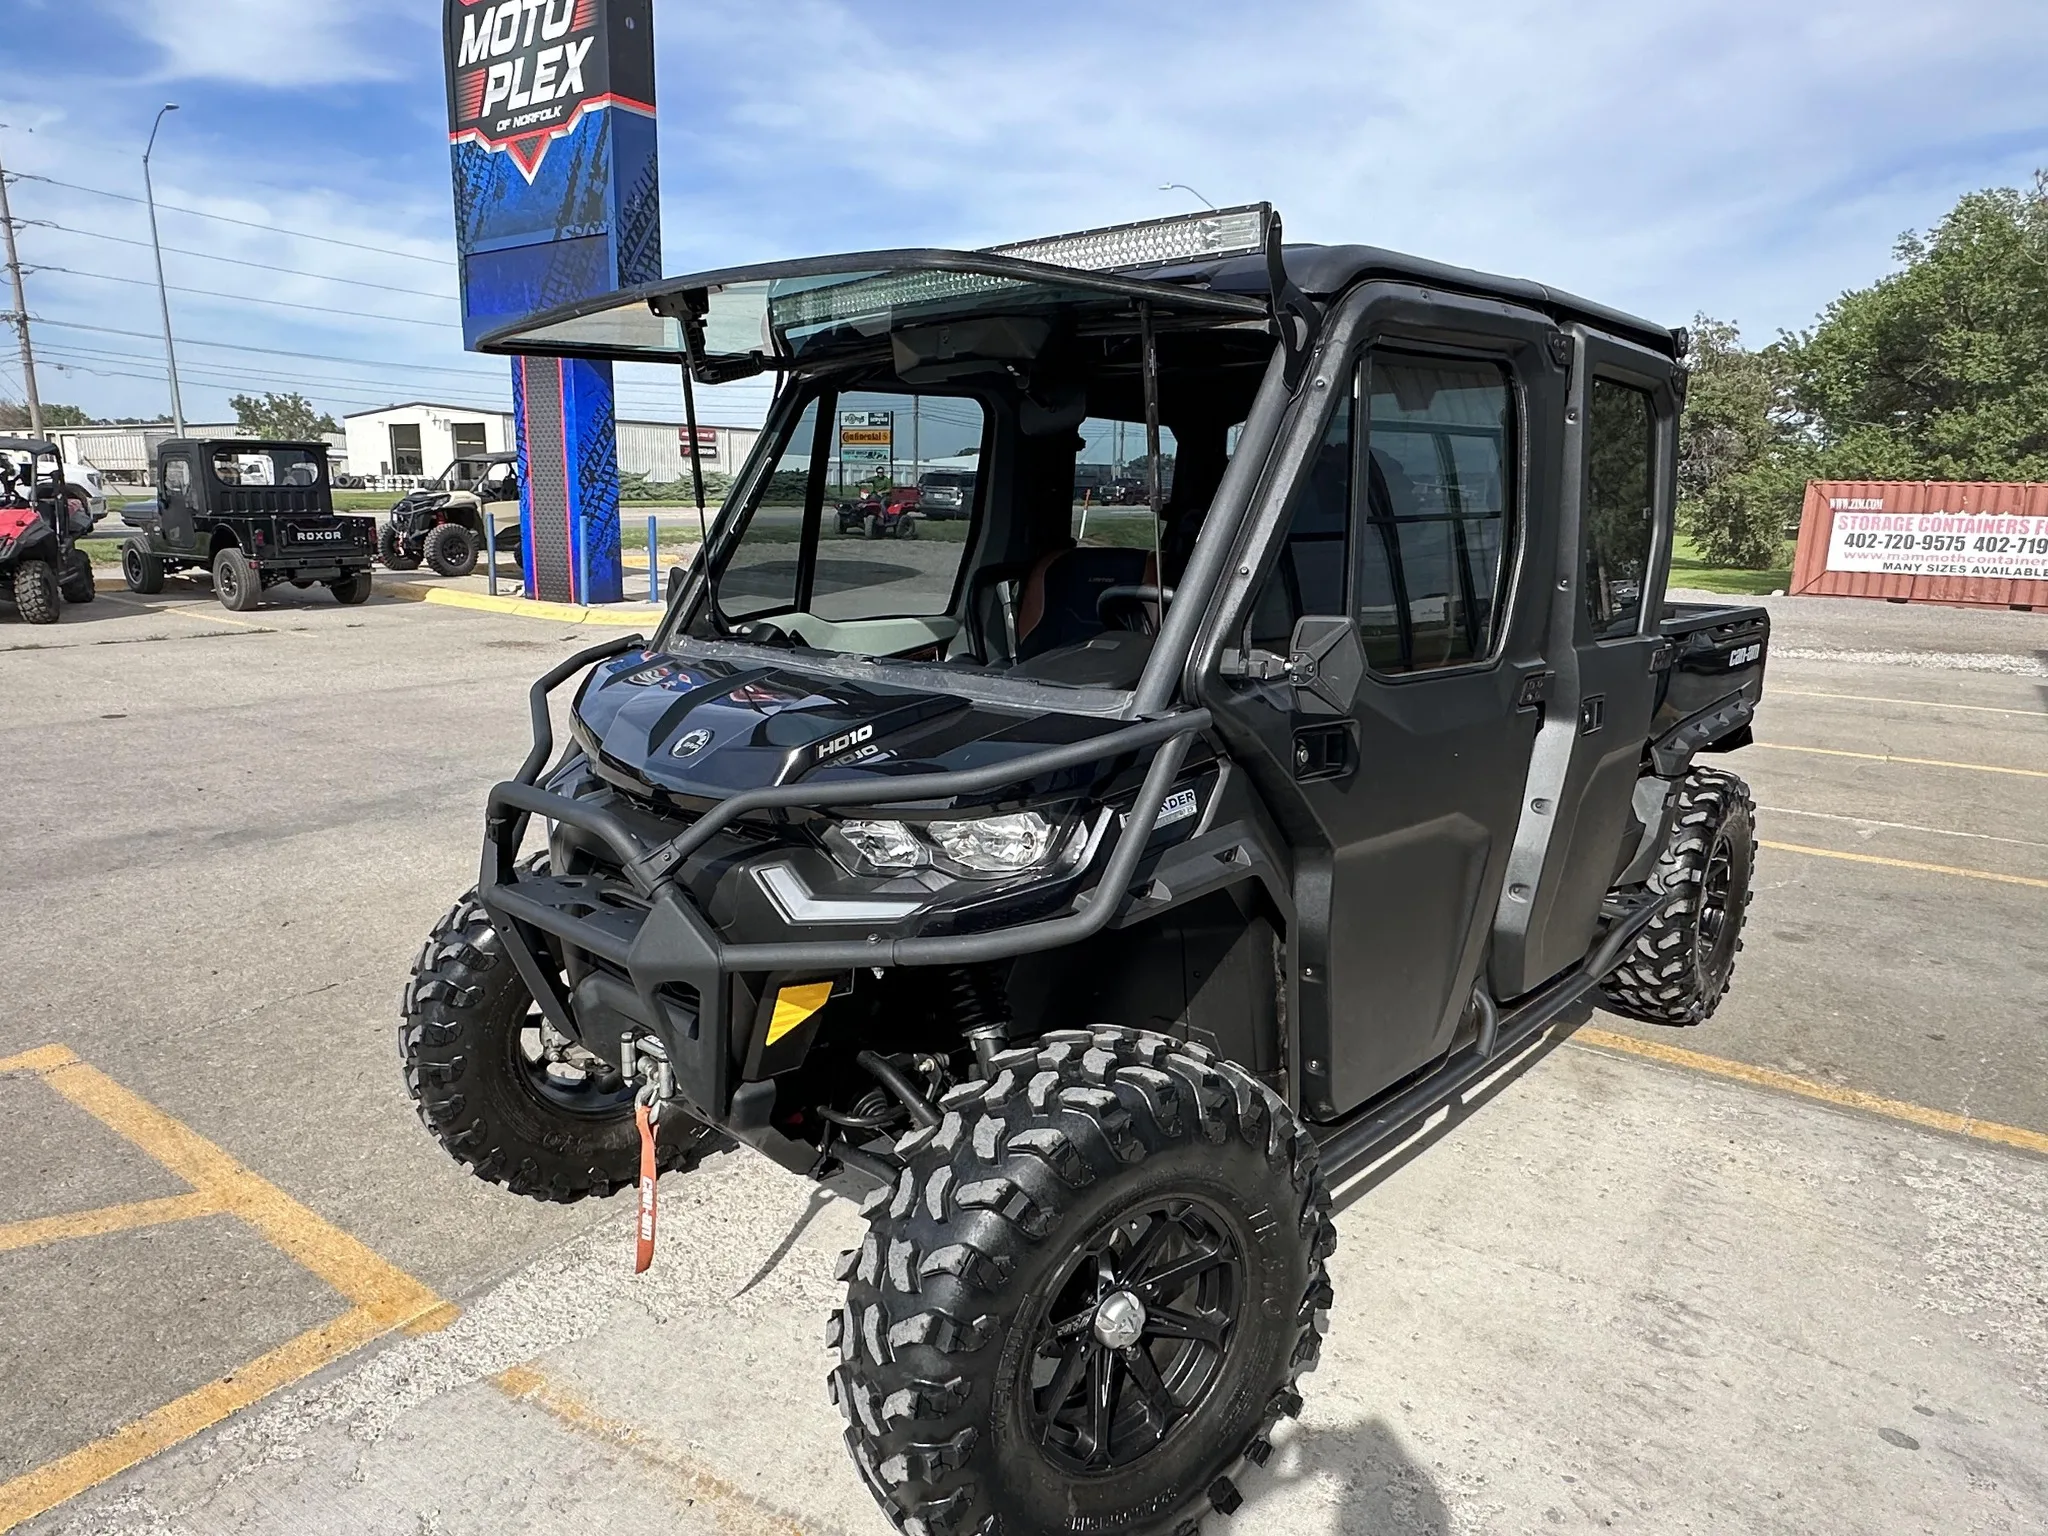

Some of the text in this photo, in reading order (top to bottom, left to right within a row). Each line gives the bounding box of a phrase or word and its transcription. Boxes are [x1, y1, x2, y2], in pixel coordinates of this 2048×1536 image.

[458, 0, 575, 67] MOTO
[481, 36, 595, 118] PLEX
[496, 105, 563, 132] OF NORFOLK
[296, 531, 342, 541] ROXOR
[1838, 515, 1914, 532] STORAGE
[1918, 516, 2031, 536] CONTAINERS
[1844, 532, 2048, 555] 402-720-9575 402-719
[1882, 562, 2048, 578] MANY SIZES AVAILABLE
[818, 724, 873, 759] HD10
